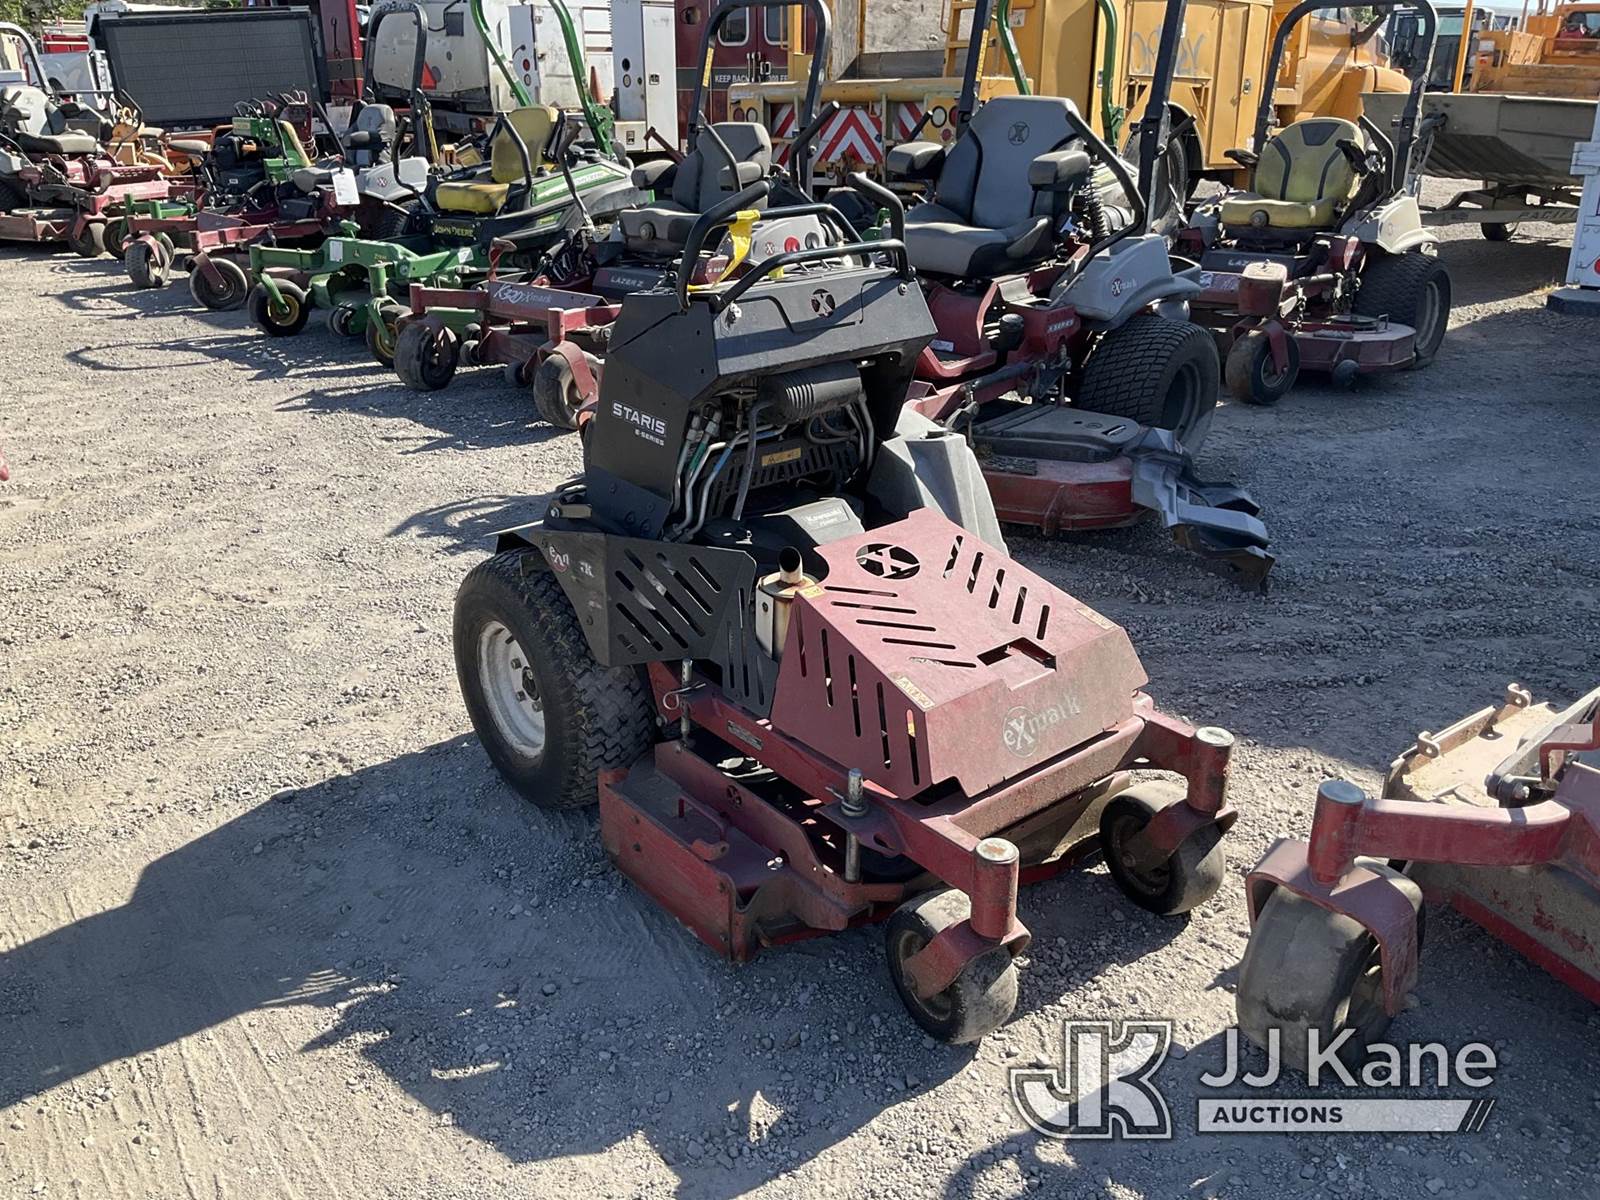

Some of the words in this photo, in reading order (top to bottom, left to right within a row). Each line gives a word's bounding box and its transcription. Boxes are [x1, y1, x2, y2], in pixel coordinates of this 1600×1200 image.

[714, 75, 731, 83] KEEP
[1517, 209, 1578, 220] PACIFI
[610, 275, 637, 287] LAZER
[612, 402, 666, 435] STARIS
